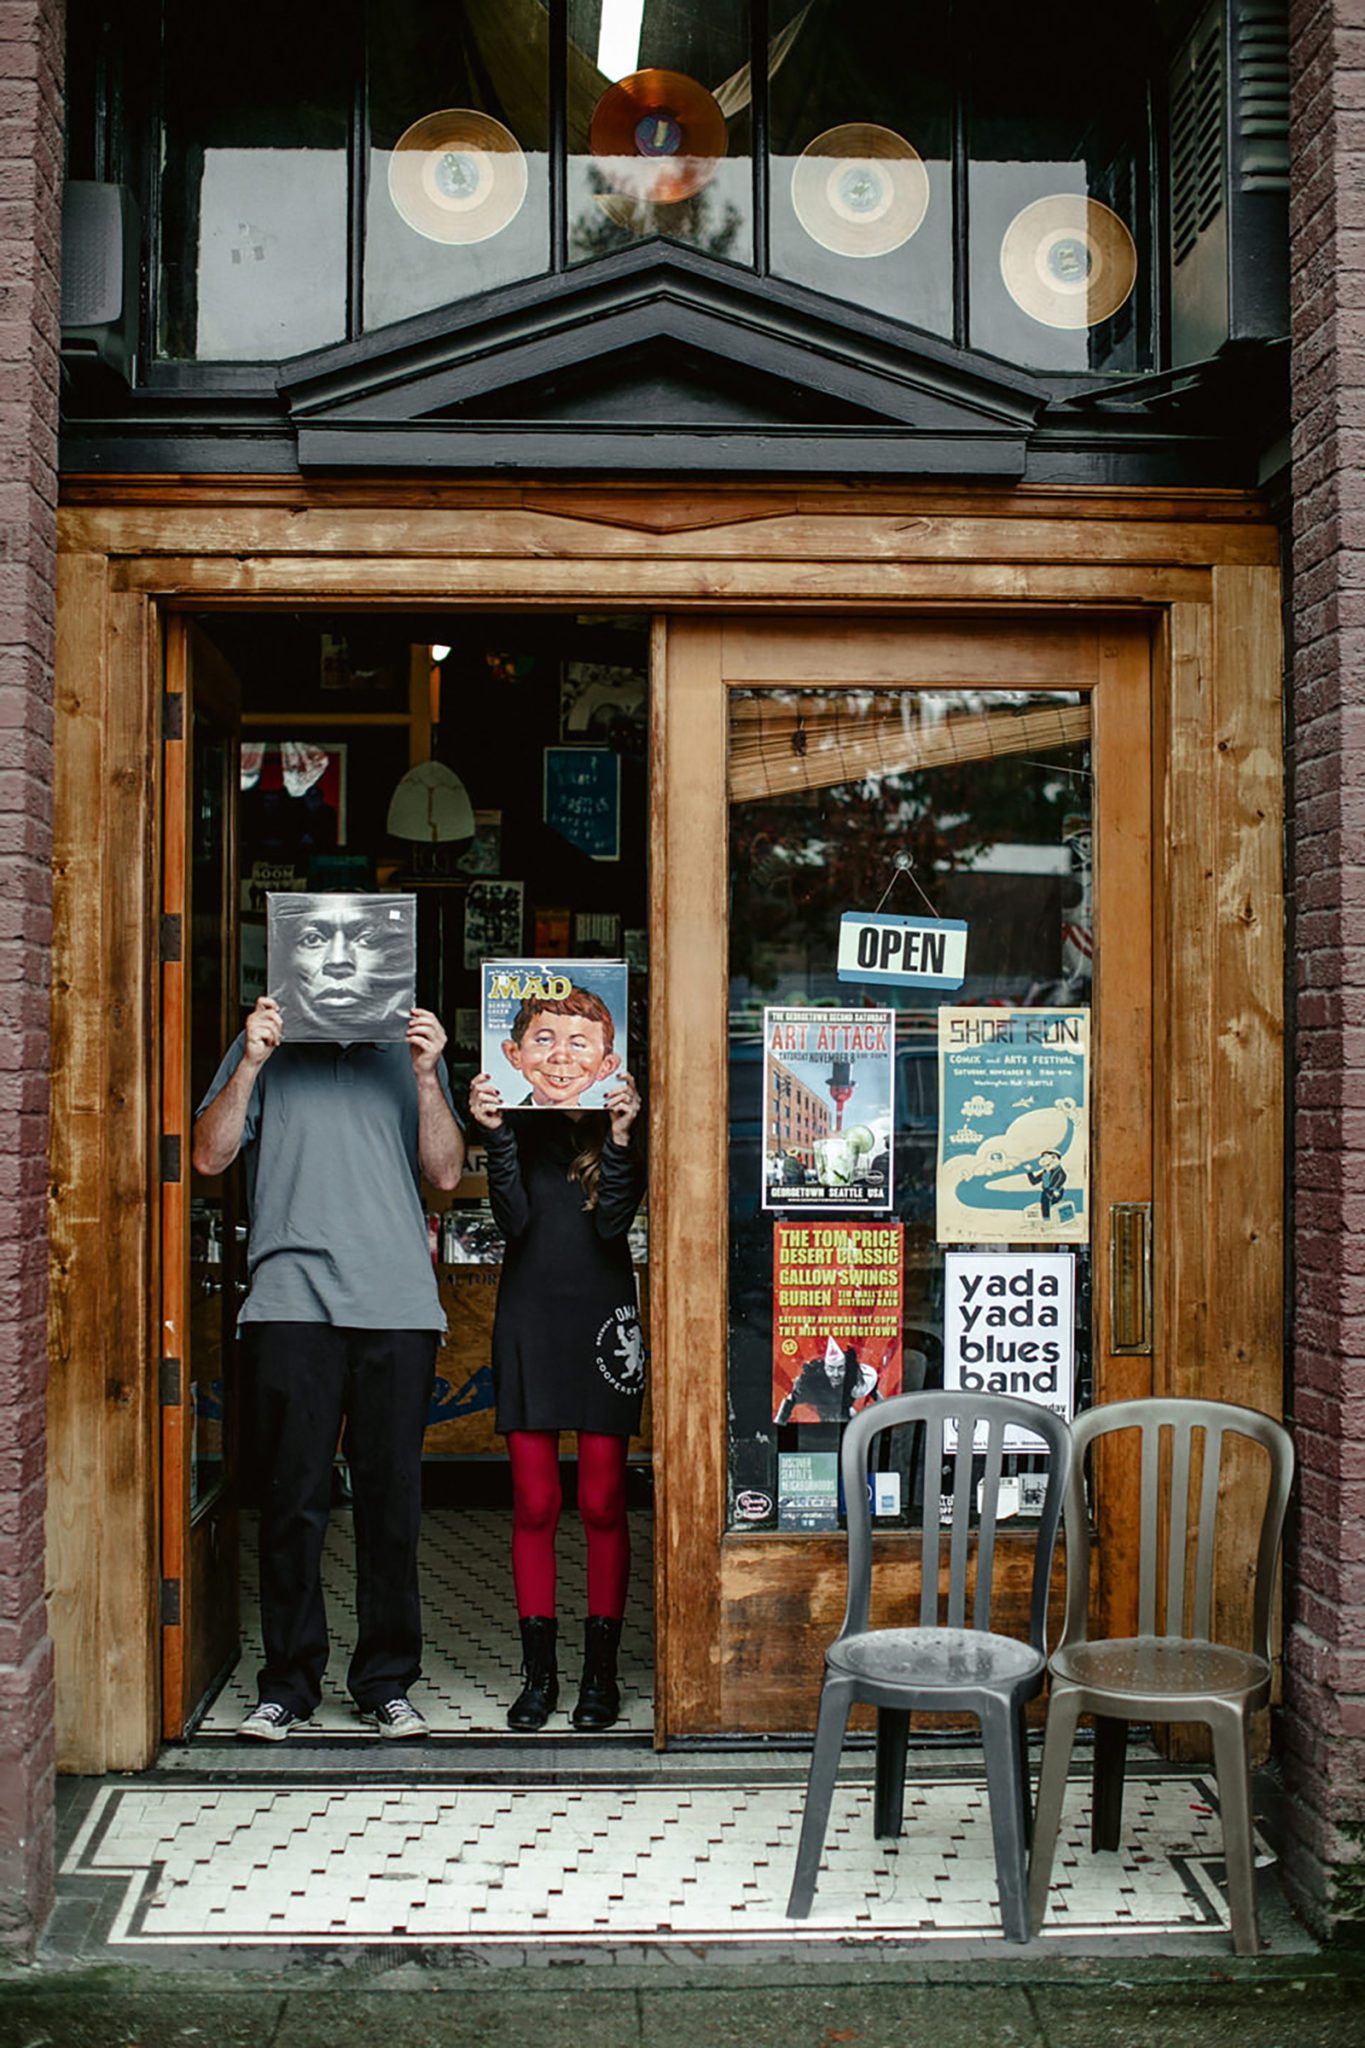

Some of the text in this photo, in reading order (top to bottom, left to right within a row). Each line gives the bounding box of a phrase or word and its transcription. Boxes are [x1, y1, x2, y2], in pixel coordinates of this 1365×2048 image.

[857, 927, 946, 974] OPEN
[488, 975, 573, 1000] MAD
[771, 1024, 887, 1051] ART ATTACK
[950, 1019, 1079, 1044] SHORT RUN
[809, 1052, 849, 1063] NOVEMBER
[949, 1055, 981, 1064] COMIX
[1004, 1055, 1028, 1064] ARTS
[1032, 1055, 1076, 1065] FESTIVAL
[771, 1188, 884, 1198] GEORGETOWN SEATTLE USA
[780, 1229, 899, 1247] THE TOM PRICE
[780, 1248, 899, 1264] DESERT CLASSIC
[780, 1269, 899, 1285] GALLOW SWINGS
[959, 1269, 1058, 1302] yada
[779, 1290, 832, 1306] BURIEN
[838, 1298, 875, 1306] BIRTHDAY
[959, 1299, 1058, 1333] yada
[779, 1326, 796, 1336] THE
[819, 1326, 830, 1336] IN
[832, 1326, 897, 1336] GEORGETOWN
[959, 1335, 1060, 1363] blues
[959, 1365, 1057, 1393] band
